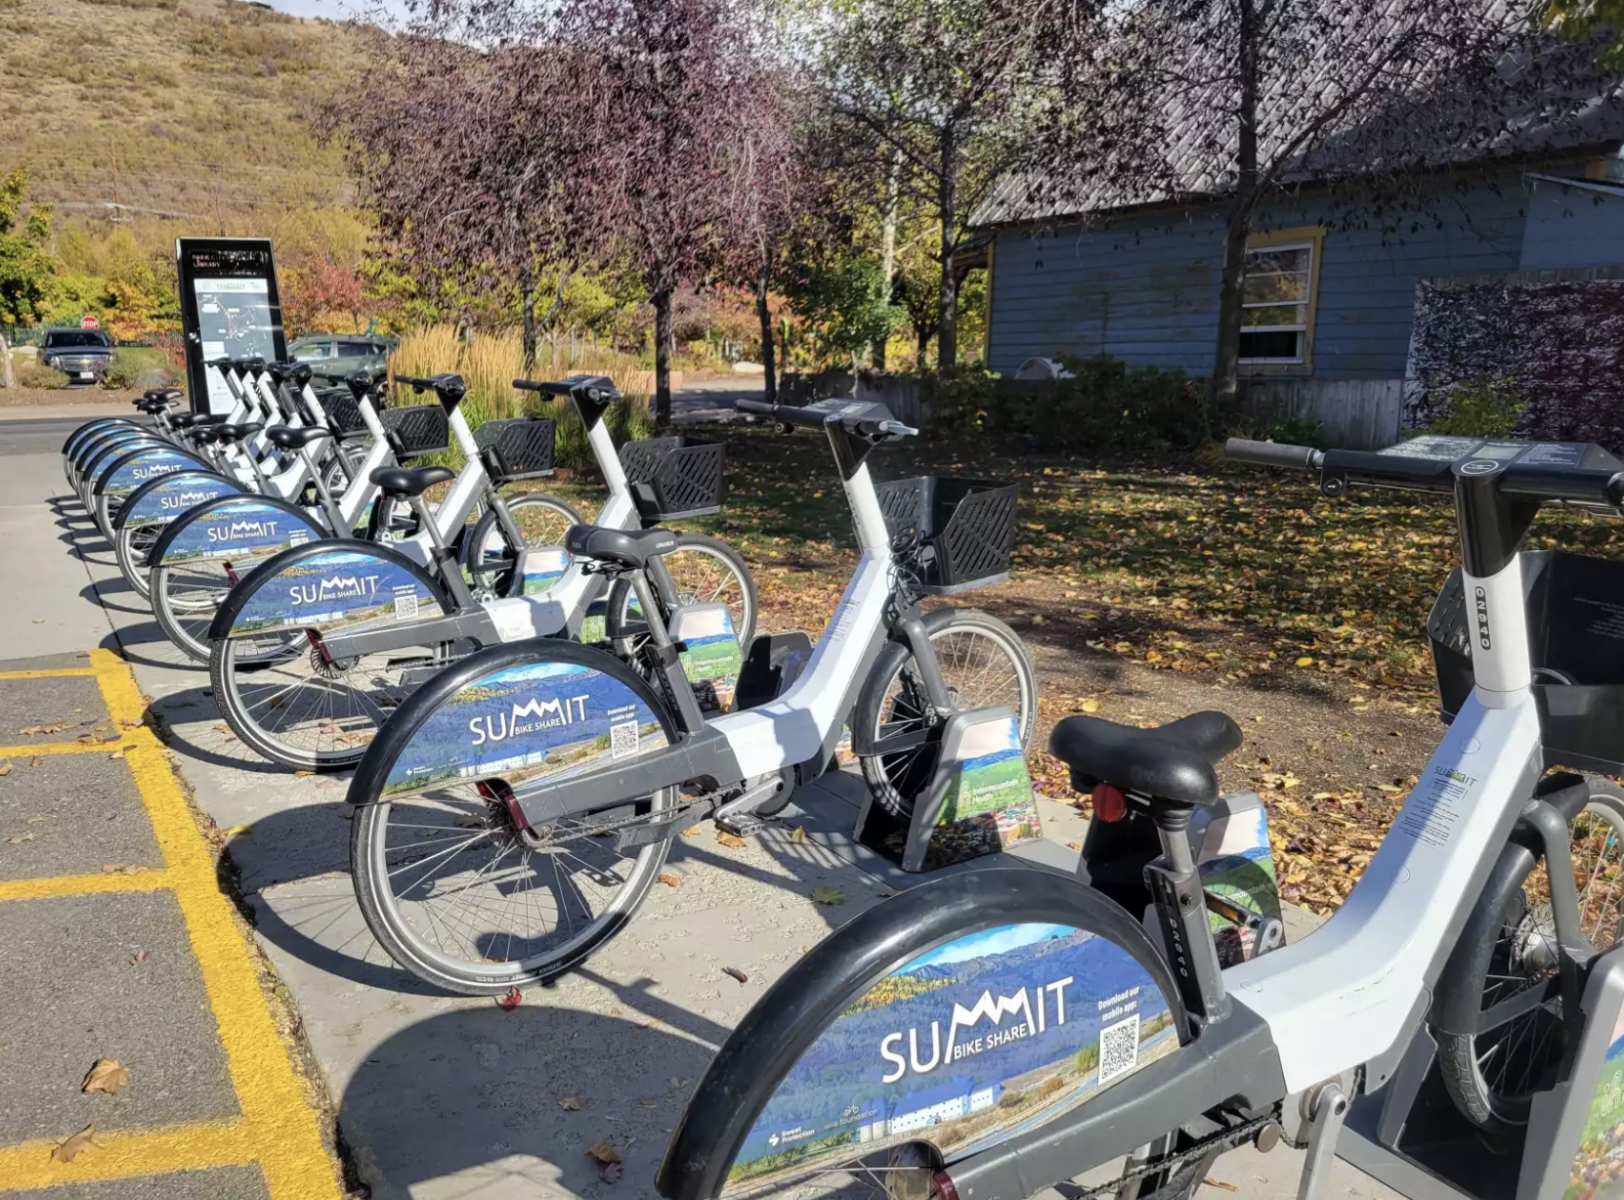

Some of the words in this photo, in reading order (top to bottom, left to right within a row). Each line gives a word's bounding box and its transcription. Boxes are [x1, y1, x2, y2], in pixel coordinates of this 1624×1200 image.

[83, 320, 98, 328] STOP
[133, 464, 182, 479] SUMMIT
[161, 491, 218, 509] SUMMIT
[207, 520, 278, 542] SUMMIT
[289, 575, 379, 605] SUMMIT
[322, 592, 336, 600] BIKE
[337, 590, 357, 598] SHARE
[1476, 587, 1490, 647] 02940
[469, 695, 590, 745] SUMMIT
[515, 723, 534, 735] BIKE
[535, 717, 562, 730] SHARE
[1433, 765, 1478, 787] SUMMIT
[973, 779, 1018, 796] Intermountain
[1098, 989, 1129, 1011] Download
[1129, 986, 1140, 997] our
[1102, 1005, 1124, 1022] mobile
[880, 976, 1074, 1083] SUMMIT
[953, 1036, 982, 1060] BIKE
[986, 1023, 1027, 1050] SHARE
[840, 1109, 879, 1125] foundation
[781, 1126, 802, 1137] Sweet
[781, 1129, 815, 1144] Protection
